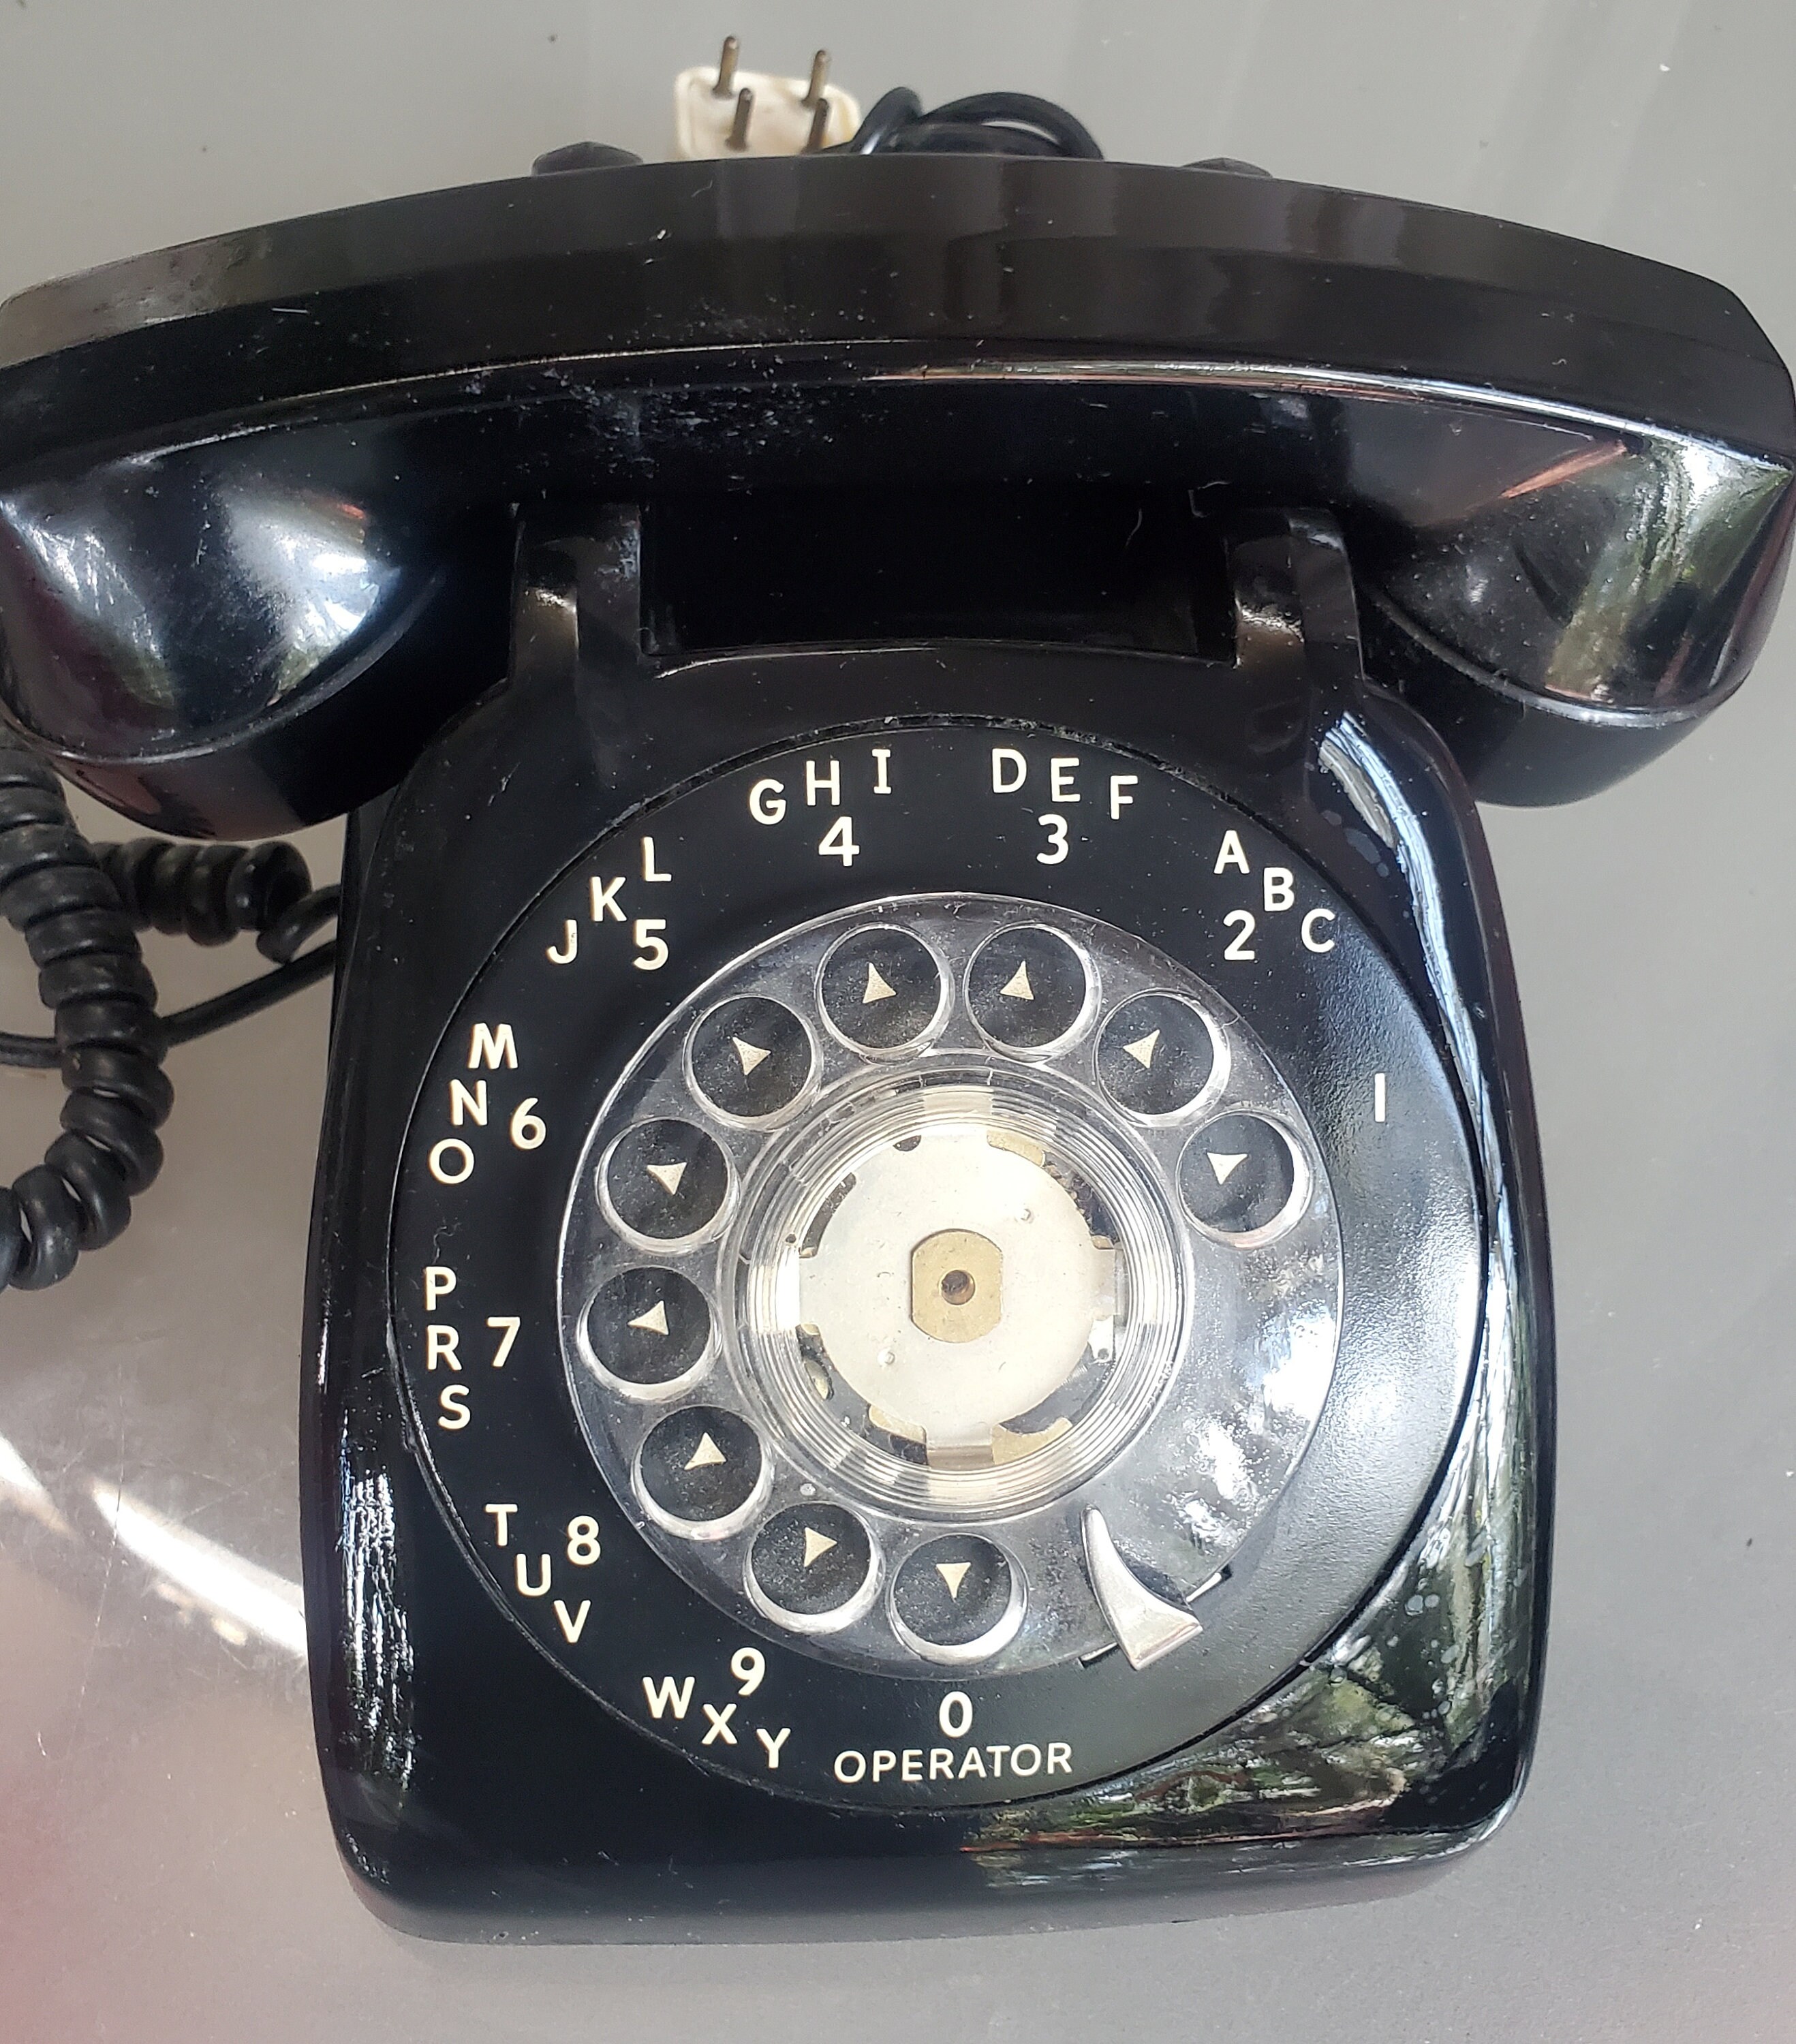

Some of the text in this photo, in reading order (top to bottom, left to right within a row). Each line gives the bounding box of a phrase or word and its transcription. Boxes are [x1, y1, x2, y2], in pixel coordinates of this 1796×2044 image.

[818, 816, 860, 867] 4
[1036, 814, 1069, 865] 3
[633, 918, 669, 970] 5
[1223, 909, 1256, 961] 2
[510, 1097, 546, 1149] 6
[486, 1316, 521, 1367] 7
[567, 1515, 601, 1566] 8
[730, 1647, 766, 1696] 9
[834, 1741, 1073, 1783] OPERATOR
